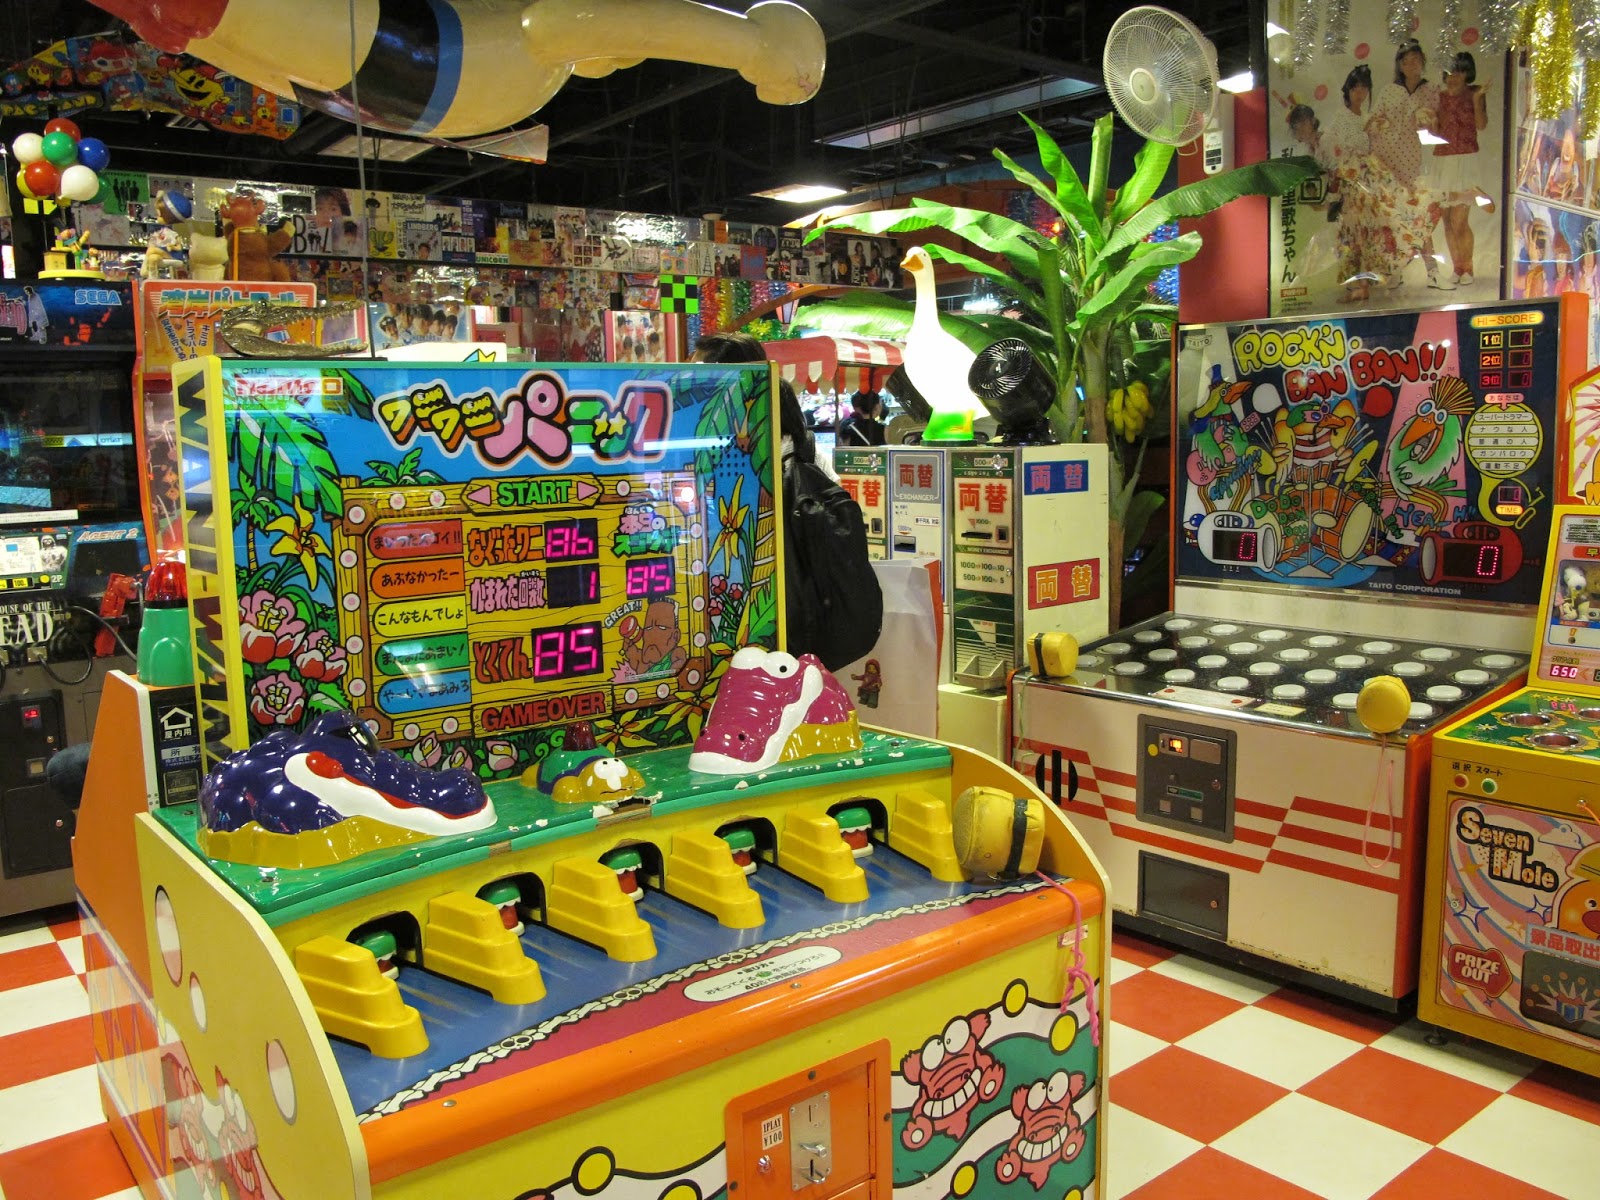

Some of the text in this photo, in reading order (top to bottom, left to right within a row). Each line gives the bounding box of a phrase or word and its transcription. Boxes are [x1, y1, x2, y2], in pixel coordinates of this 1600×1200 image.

[406, 222, 439, 232] LINDBERG
[475, 255, 509, 264] UNICORN
[74, 289, 122, 305] SEGA
[1477, 313, 1537, 327] HI-SCORE
[1186, 337, 1211, 347] TAITO
[1482, 334, 1501, 345] 1位
[1233, 325, 1346, 375] ROCK'N
[1482, 355, 1501, 366] 2位
[1286, 364, 1348, 403] BAN
[1350, 342, 1447, 386] BAN!!
[1481, 375, 1501, 386] 3位
[899, 464, 933, 489] 両替
[1030, 464, 1083, 493] 両替
[497, 480, 572, 507] START
[958, 483, 1008, 514] 両替
[1499, 506, 1519, 515] TIME
[77, 527, 139, 543] AGENT 2
[467, 524, 545, 567] なぐったワニ
[1239, 532, 1256, 560] 0
[1476, 545, 1499, 576] 0
[50, 574, 64, 583] 2P
[381, 568, 460, 587] あぶなかったー
[589, 570, 597, 600] 1
[626, 563, 672, 596] 85
[1035, 564, 1093, 604] 両替
[469, 573, 546, 614] かまれた回数
[1368, 581, 1462, 596] TAITO CORPORATION
[23, 602, 34, 612] OF
[36, 600, 52, 611] THE
[604, 600, 643, 629] GREAT!!
[377, 607, 465, 626] こんなもんでしょ
[473, 636, 534, 684] とくてん
[534, 627, 598, 678] 85
[1551, 665, 1578, 678] 650
[165, 727, 192, 739] 屋内用
[1452, 762, 1503, 777] 選択 スタート
[1457, 807, 1533, 856] Seven
[1489, 846, 1559, 892] Mole
[1455, 951, 1501, 975] PRIZE
[1461, 965, 1493, 984] OUT
[763, 1116, 781, 1134] 1PLAY
[763, 1131, 783, 1147] ¥100
